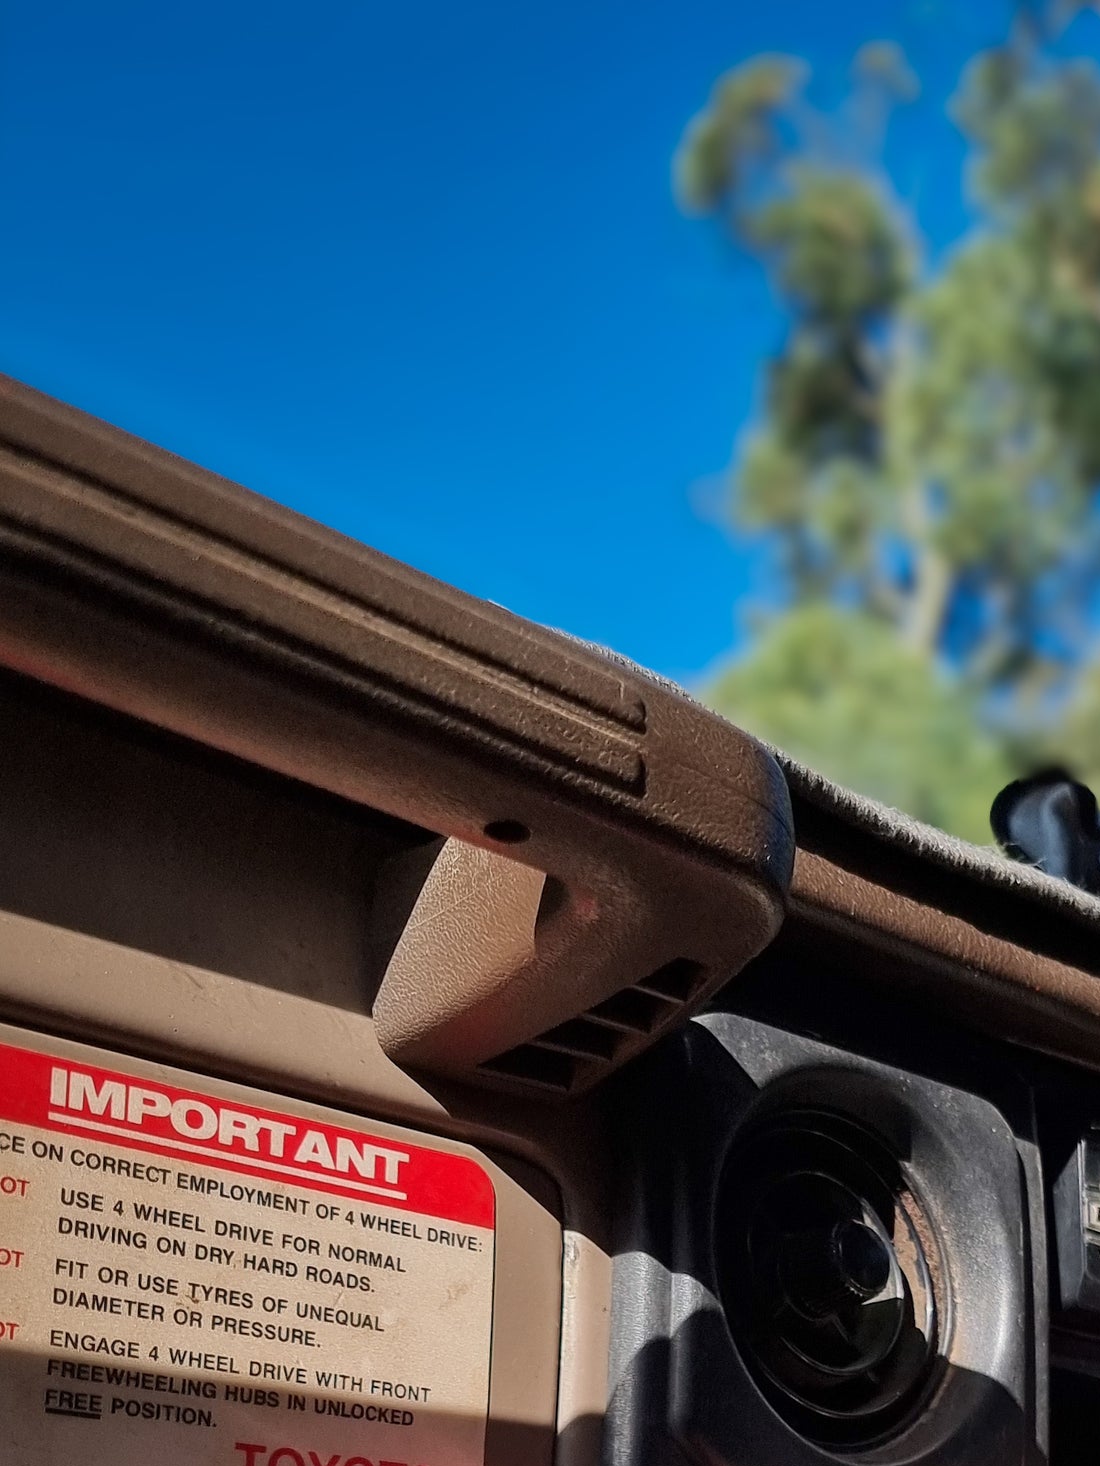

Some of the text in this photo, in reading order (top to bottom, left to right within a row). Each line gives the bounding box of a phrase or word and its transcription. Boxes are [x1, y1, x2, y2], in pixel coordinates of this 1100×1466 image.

[49, 1067, 409, 1185] IMPORTANT
[32, 1141, 63, 1162] ON
[70, 1149, 171, 1185] CORRECT
[176, 1173, 310, 1216] EMPLOYMENT
[316, 1204, 340, 1221] OF
[344, 1211, 356, 1225] 4
[360, 1213, 422, 1241] WHEEL
[427, 1227, 483, 1253] DRIVE:
[61, 1188, 406, 1273] USE 4 WHEEL DRIVE FOR NORMAL
[58, 1217, 147, 1249] DRIVING
[156, 1236, 187, 1257] ON
[243, 1254, 298, 1279] HARD
[306, 1266, 375, 1293] ROADS.
[53, 1288, 321, 1348] DIAMETER OR PRESSURE.
[55, 1258, 384, 1332] FIT OR USE TYRES OF UNEQUAL
[46, 1360, 414, 1426] FREEWHEELING HUBS IN UNLOCKED
[50, 1330, 431, 1403] ENGAGE 4 WHEEL DRIVE WITH FRONT
[45, 1390, 217, 1428] FREE POSITION.
